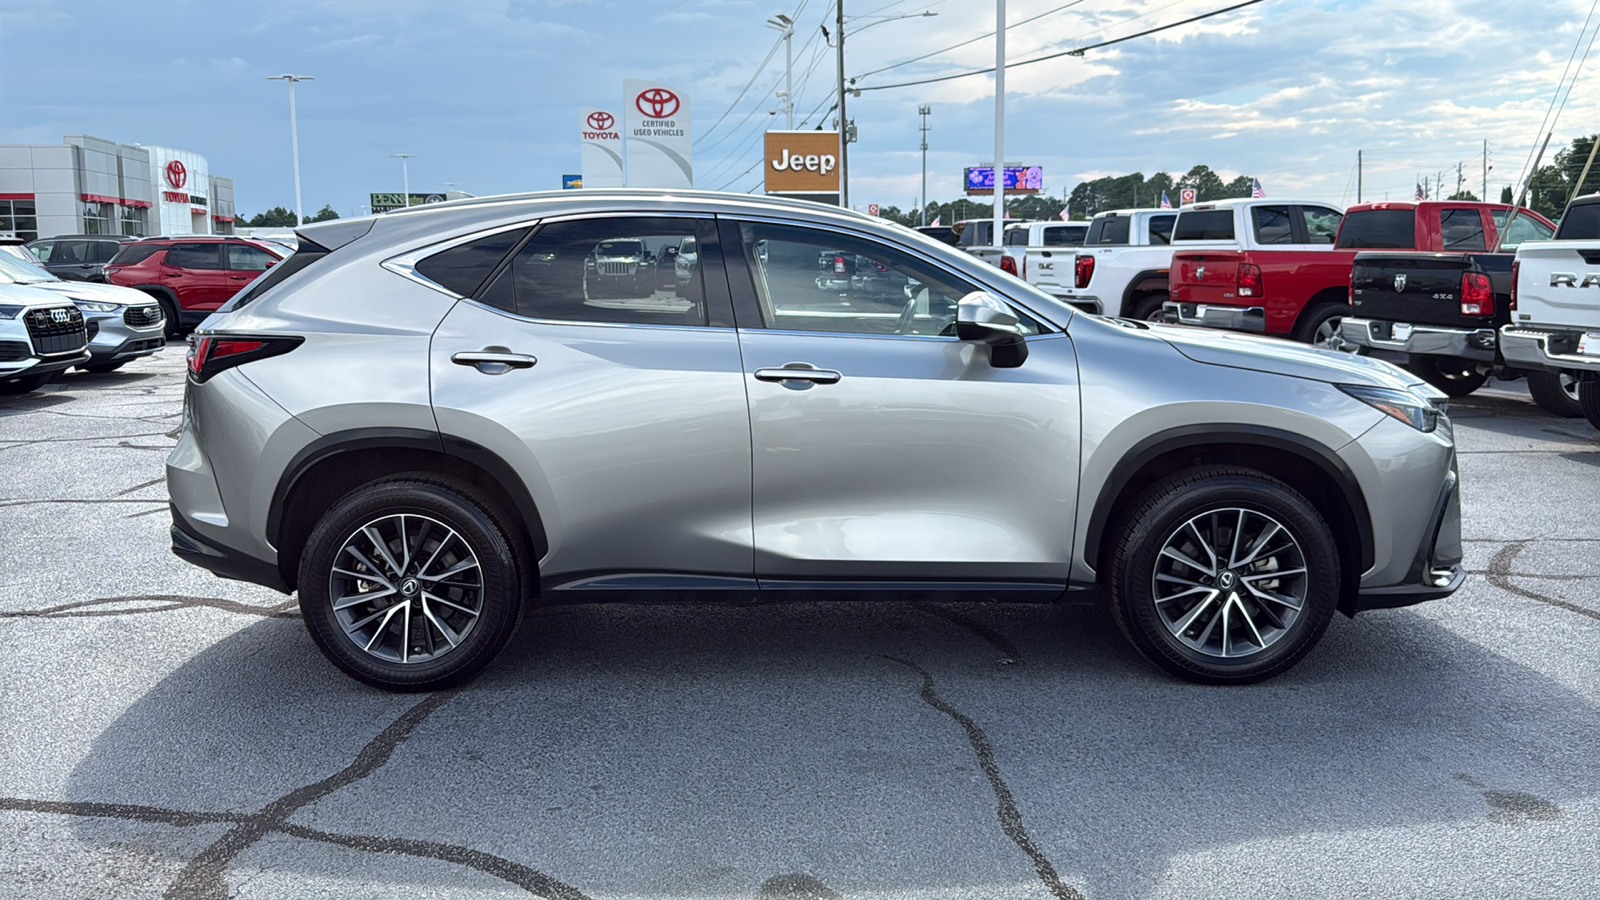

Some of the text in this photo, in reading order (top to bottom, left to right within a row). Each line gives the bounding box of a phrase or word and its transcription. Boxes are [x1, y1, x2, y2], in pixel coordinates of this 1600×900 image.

[642, 120, 675, 128] CERTIFIED
[582, 132, 620, 140] TOYOTA
[654, 129, 684, 137] VEHICLES
[772, 149, 835, 175] Jeep
[163, 191, 189, 203] TOYOTA
